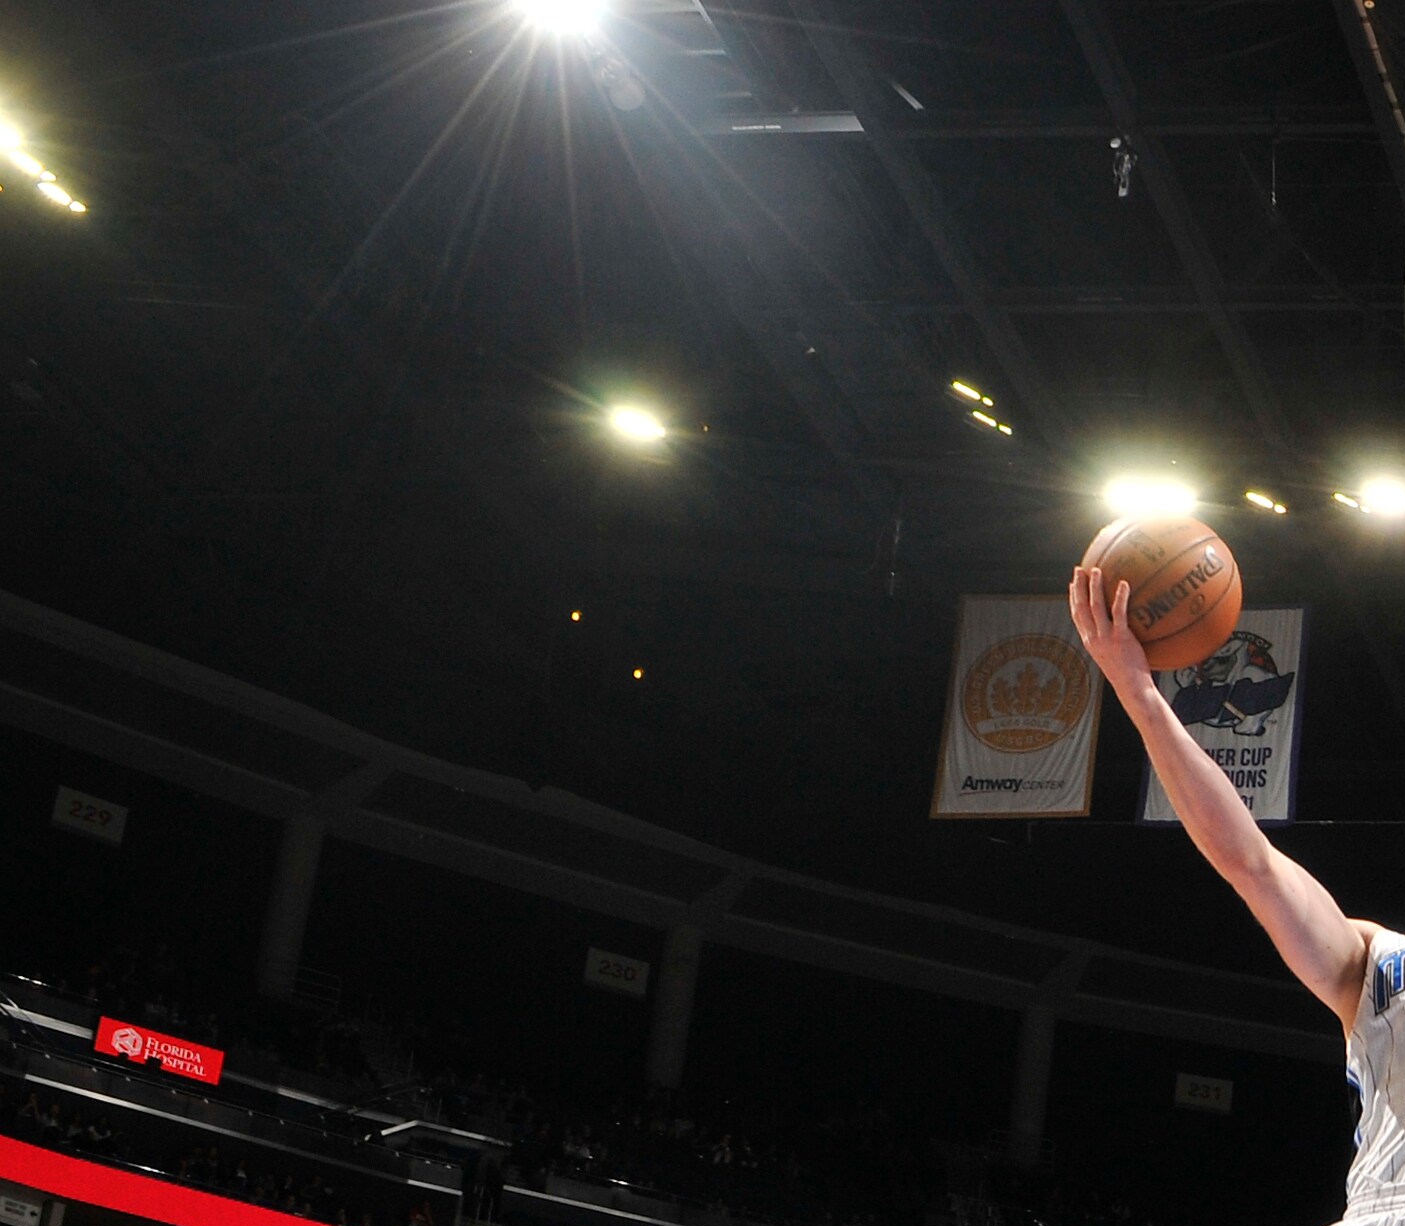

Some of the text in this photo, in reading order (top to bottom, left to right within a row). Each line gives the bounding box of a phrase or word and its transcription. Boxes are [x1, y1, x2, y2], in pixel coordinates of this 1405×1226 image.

[1240, 747, 1272, 766] CUP
[961, 775, 1022, 792] Amway
[600, 961, 635, 981] 230
[146, 1037, 201, 1063] FLORIDA
